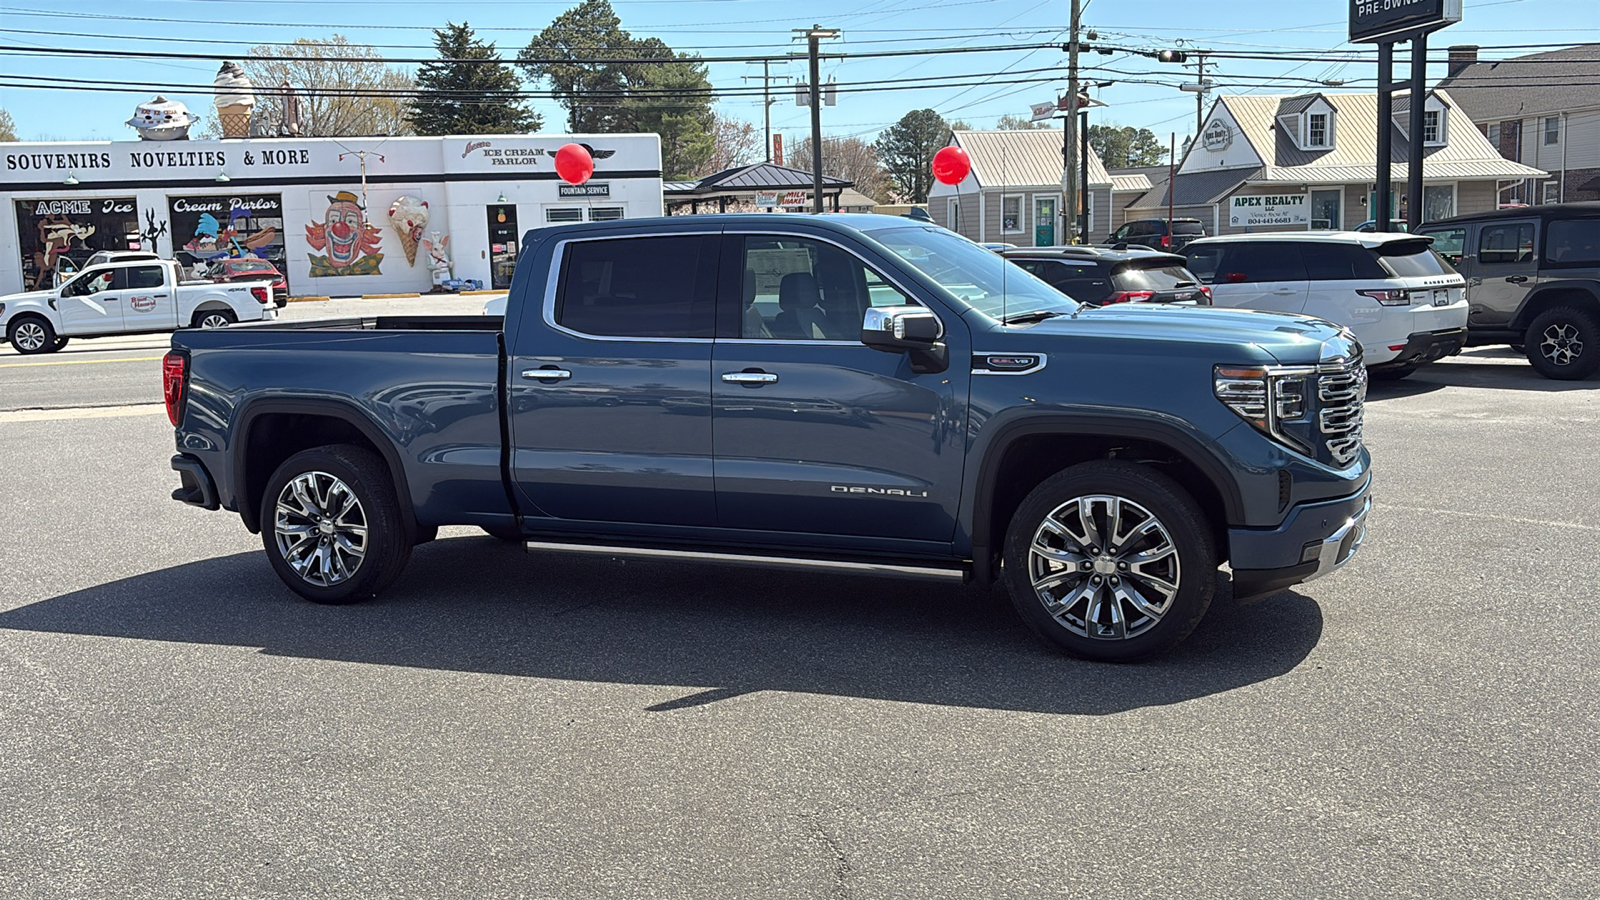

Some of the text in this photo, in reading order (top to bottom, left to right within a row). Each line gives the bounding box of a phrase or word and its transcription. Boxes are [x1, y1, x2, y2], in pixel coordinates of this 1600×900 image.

[1358, 0, 1423, 17] PRE-OWN
[483, 148, 545, 157] ICE CREAM
[6, 149, 310, 170] SOUVENIRS NOVELTIES & MORE
[491, 157, 537, 166] PARLOR
[560, 186, 608, 196] FOUNTAIN SERVICE
[35, 199, 134, 215] ACME Ice
[173, 197, 279, 213] Cream Parlor
[1234, 195, 1305, 207] APEX REALTY
[830, 485, 928, 498] DENALI
